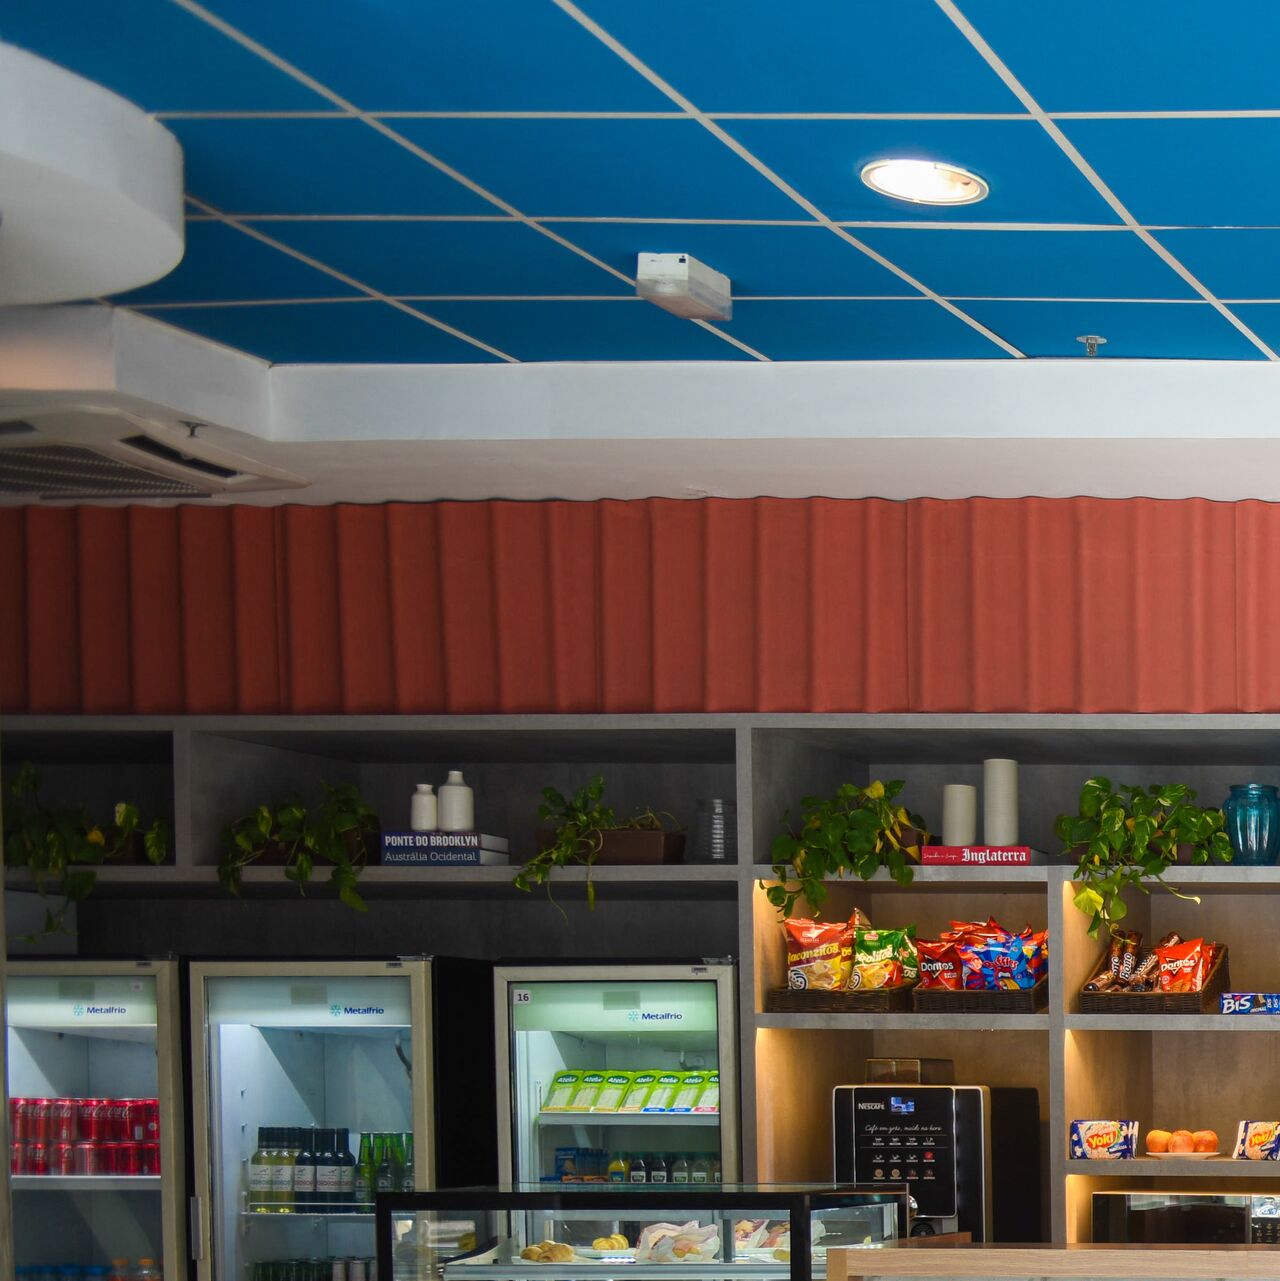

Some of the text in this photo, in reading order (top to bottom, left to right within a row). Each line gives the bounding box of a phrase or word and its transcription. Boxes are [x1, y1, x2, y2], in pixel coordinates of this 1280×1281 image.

[385, 835, 478, 847] PONTE DO BROOKLYN
[384, 851, 477, 862] Austrália Ocidental
[961, 848, 1027, 864] Inglaterra
[920, 960, 955, 972] Doritos
[1160, 958, 1196, 973] Doritos
[517, 993, 529, 1001] 16
[86, 1005, 127, 1014] Metalfrio
[343, 1006, 385, 1015] Metalfrio
[641, 1012, 683, 1021] Metalfrio
[1088, 1132, 1115, 1148] Yoki
